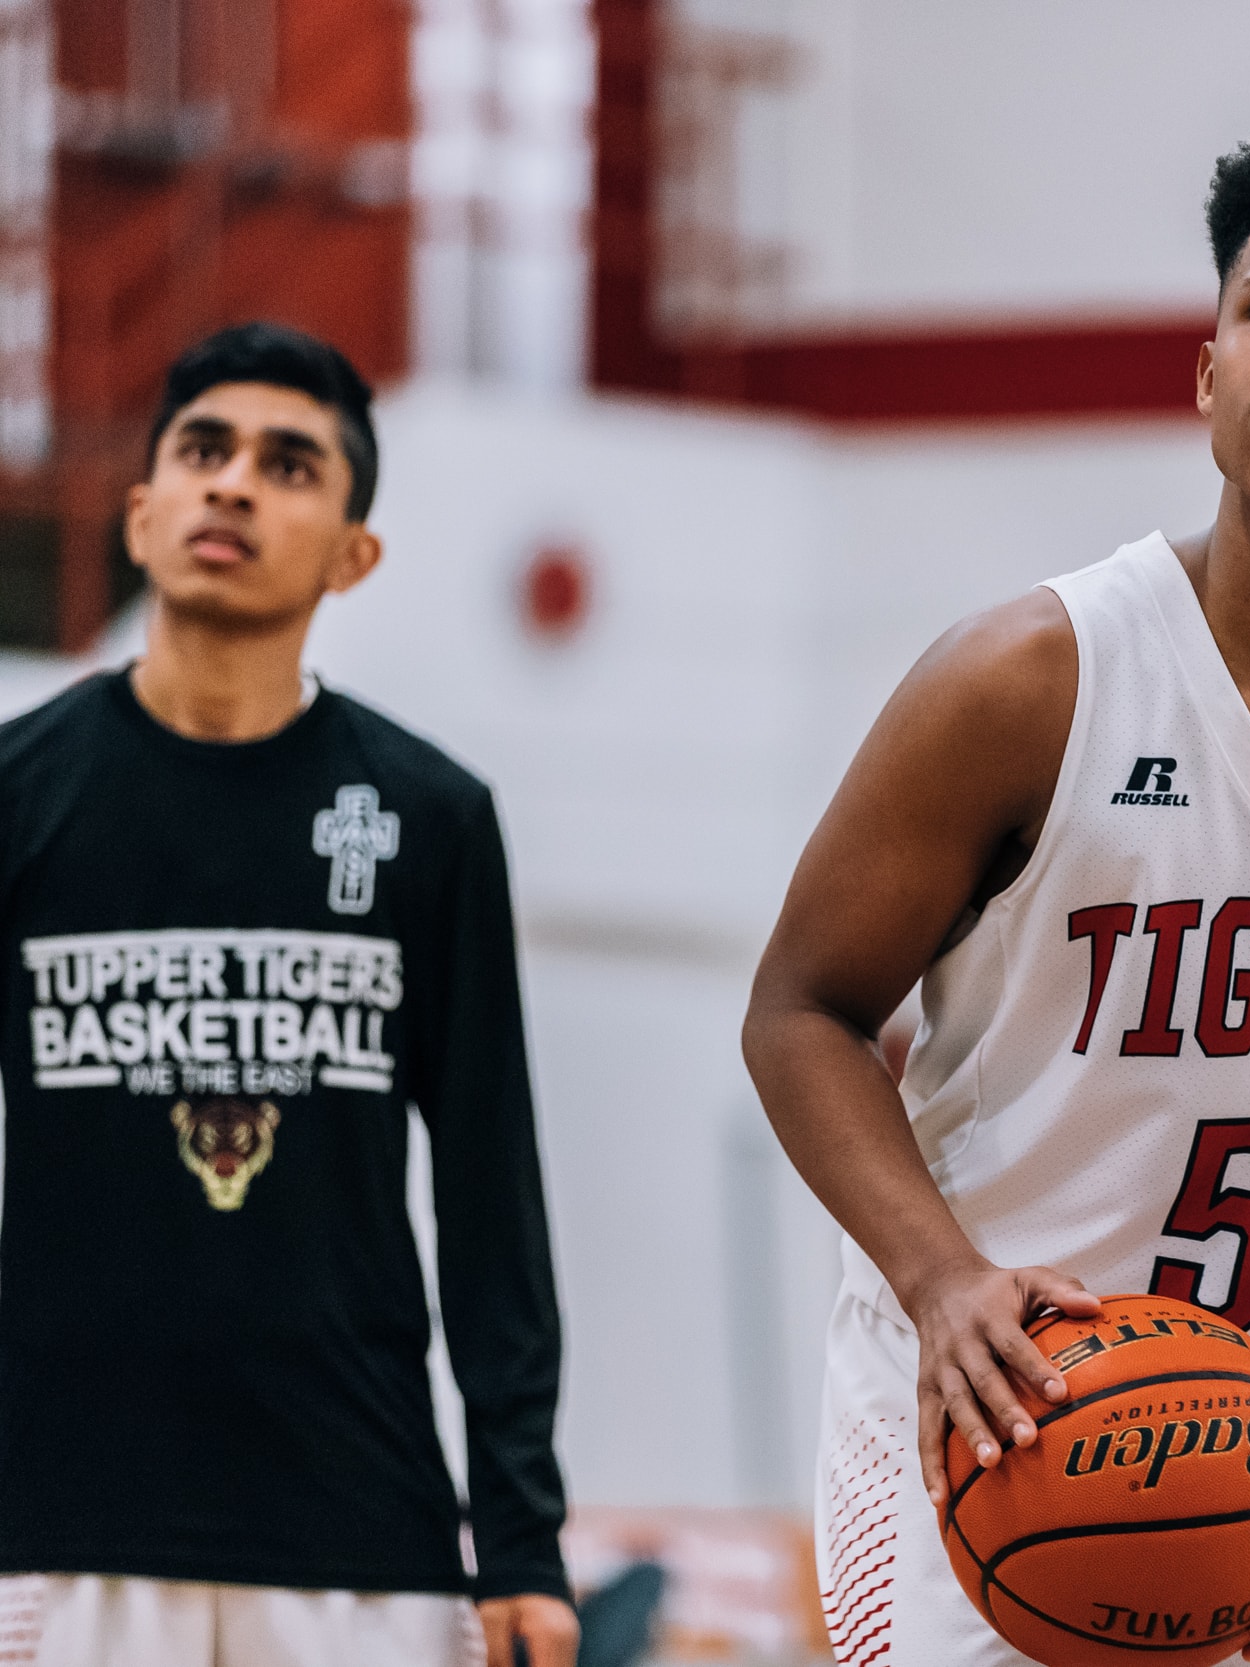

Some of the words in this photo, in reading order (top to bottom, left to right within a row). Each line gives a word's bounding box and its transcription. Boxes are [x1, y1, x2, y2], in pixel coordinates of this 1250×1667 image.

[1110, 792, 1190, 807] RUSSELL
[21, 942, 229, 1005] TUPPER
[232, 942, 404, 1010] TIGERS
[28, 1000, 395, 1070] BASKETBALL
[125, 1062, 178, 1096] WE
[180, 1062, 239, 1095] THE
[241, 1062, 314, 1096] EAST
[1050, 1318, 1250, 1373] ELITE
[1090, 1602, 1195, 1640] JUV.
